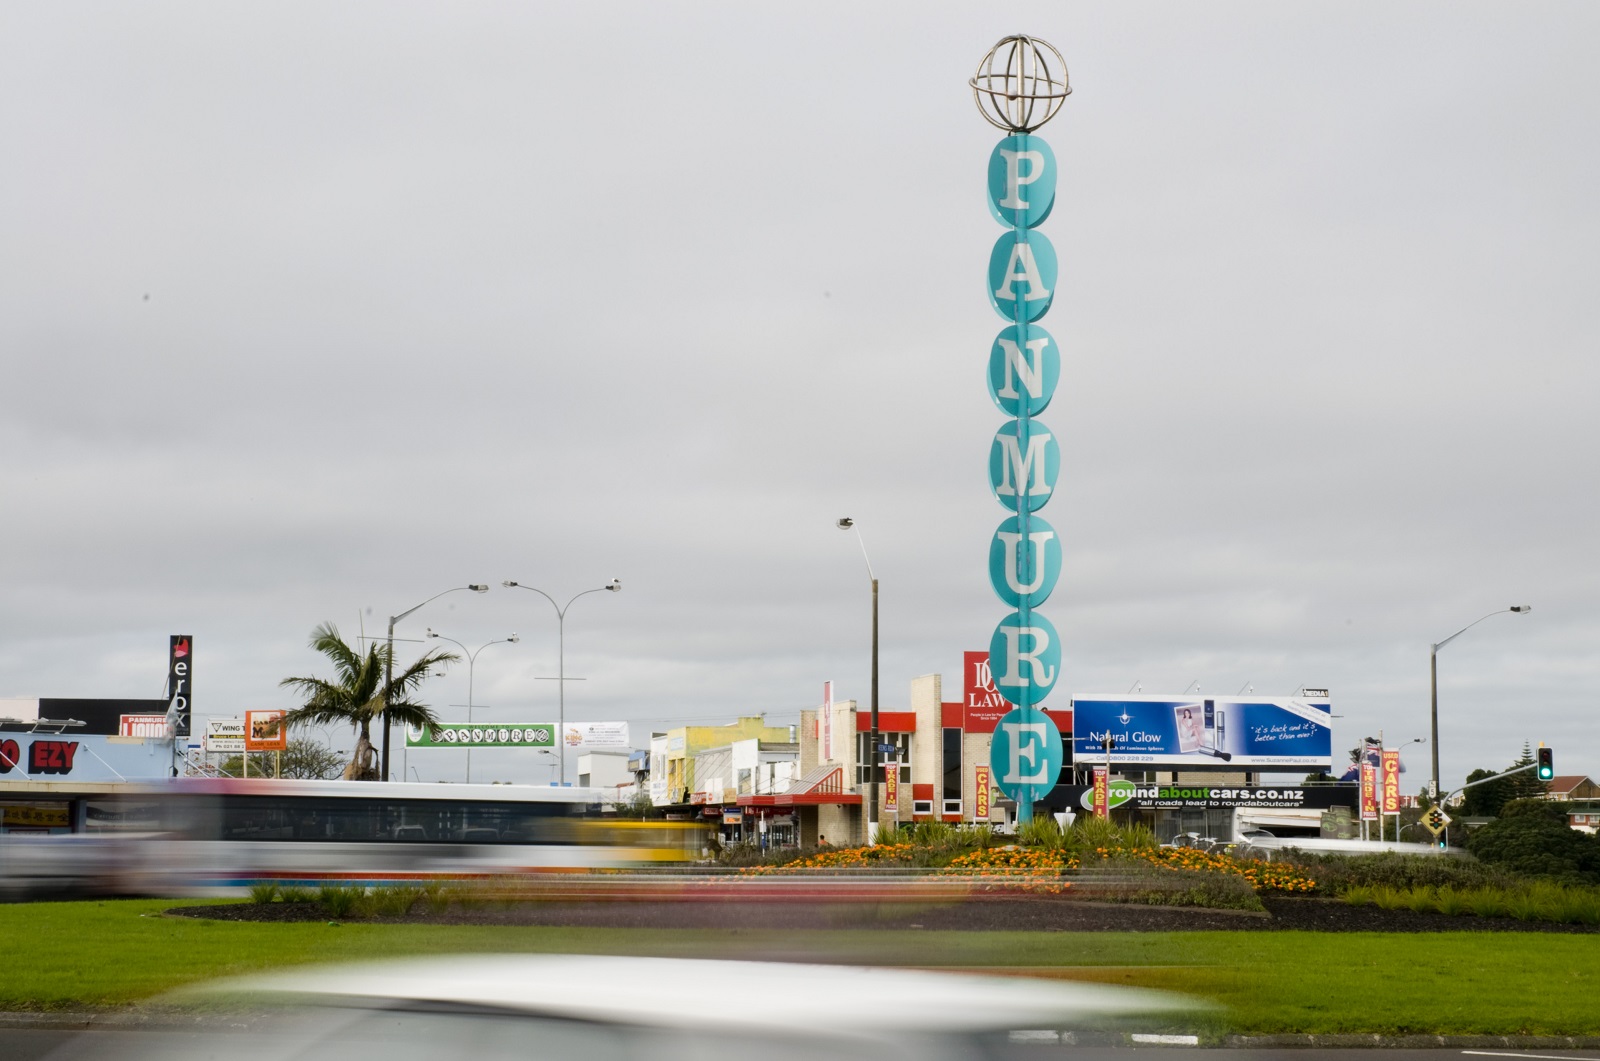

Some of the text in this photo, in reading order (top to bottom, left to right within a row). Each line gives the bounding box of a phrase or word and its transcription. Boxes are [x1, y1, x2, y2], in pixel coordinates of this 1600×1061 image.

[996, 150, 1054, 784] PANMURE
[969, 693, 1006, 707] LAW
[444, 730, 535, 741] PANMURE
[1090, 731, 1161, 742] Naural Glow
[1255, 734, 1276, 742] better
[1278, 732, 1295, 740] than
[1270, 724, 1287, 733] back
[29, 741, 79, 773] EZY
[977, 773, 988, 816] CARS
[1096, 776, 1105, 806] TRADE
[1385, 760, 1397, 810] CARS
